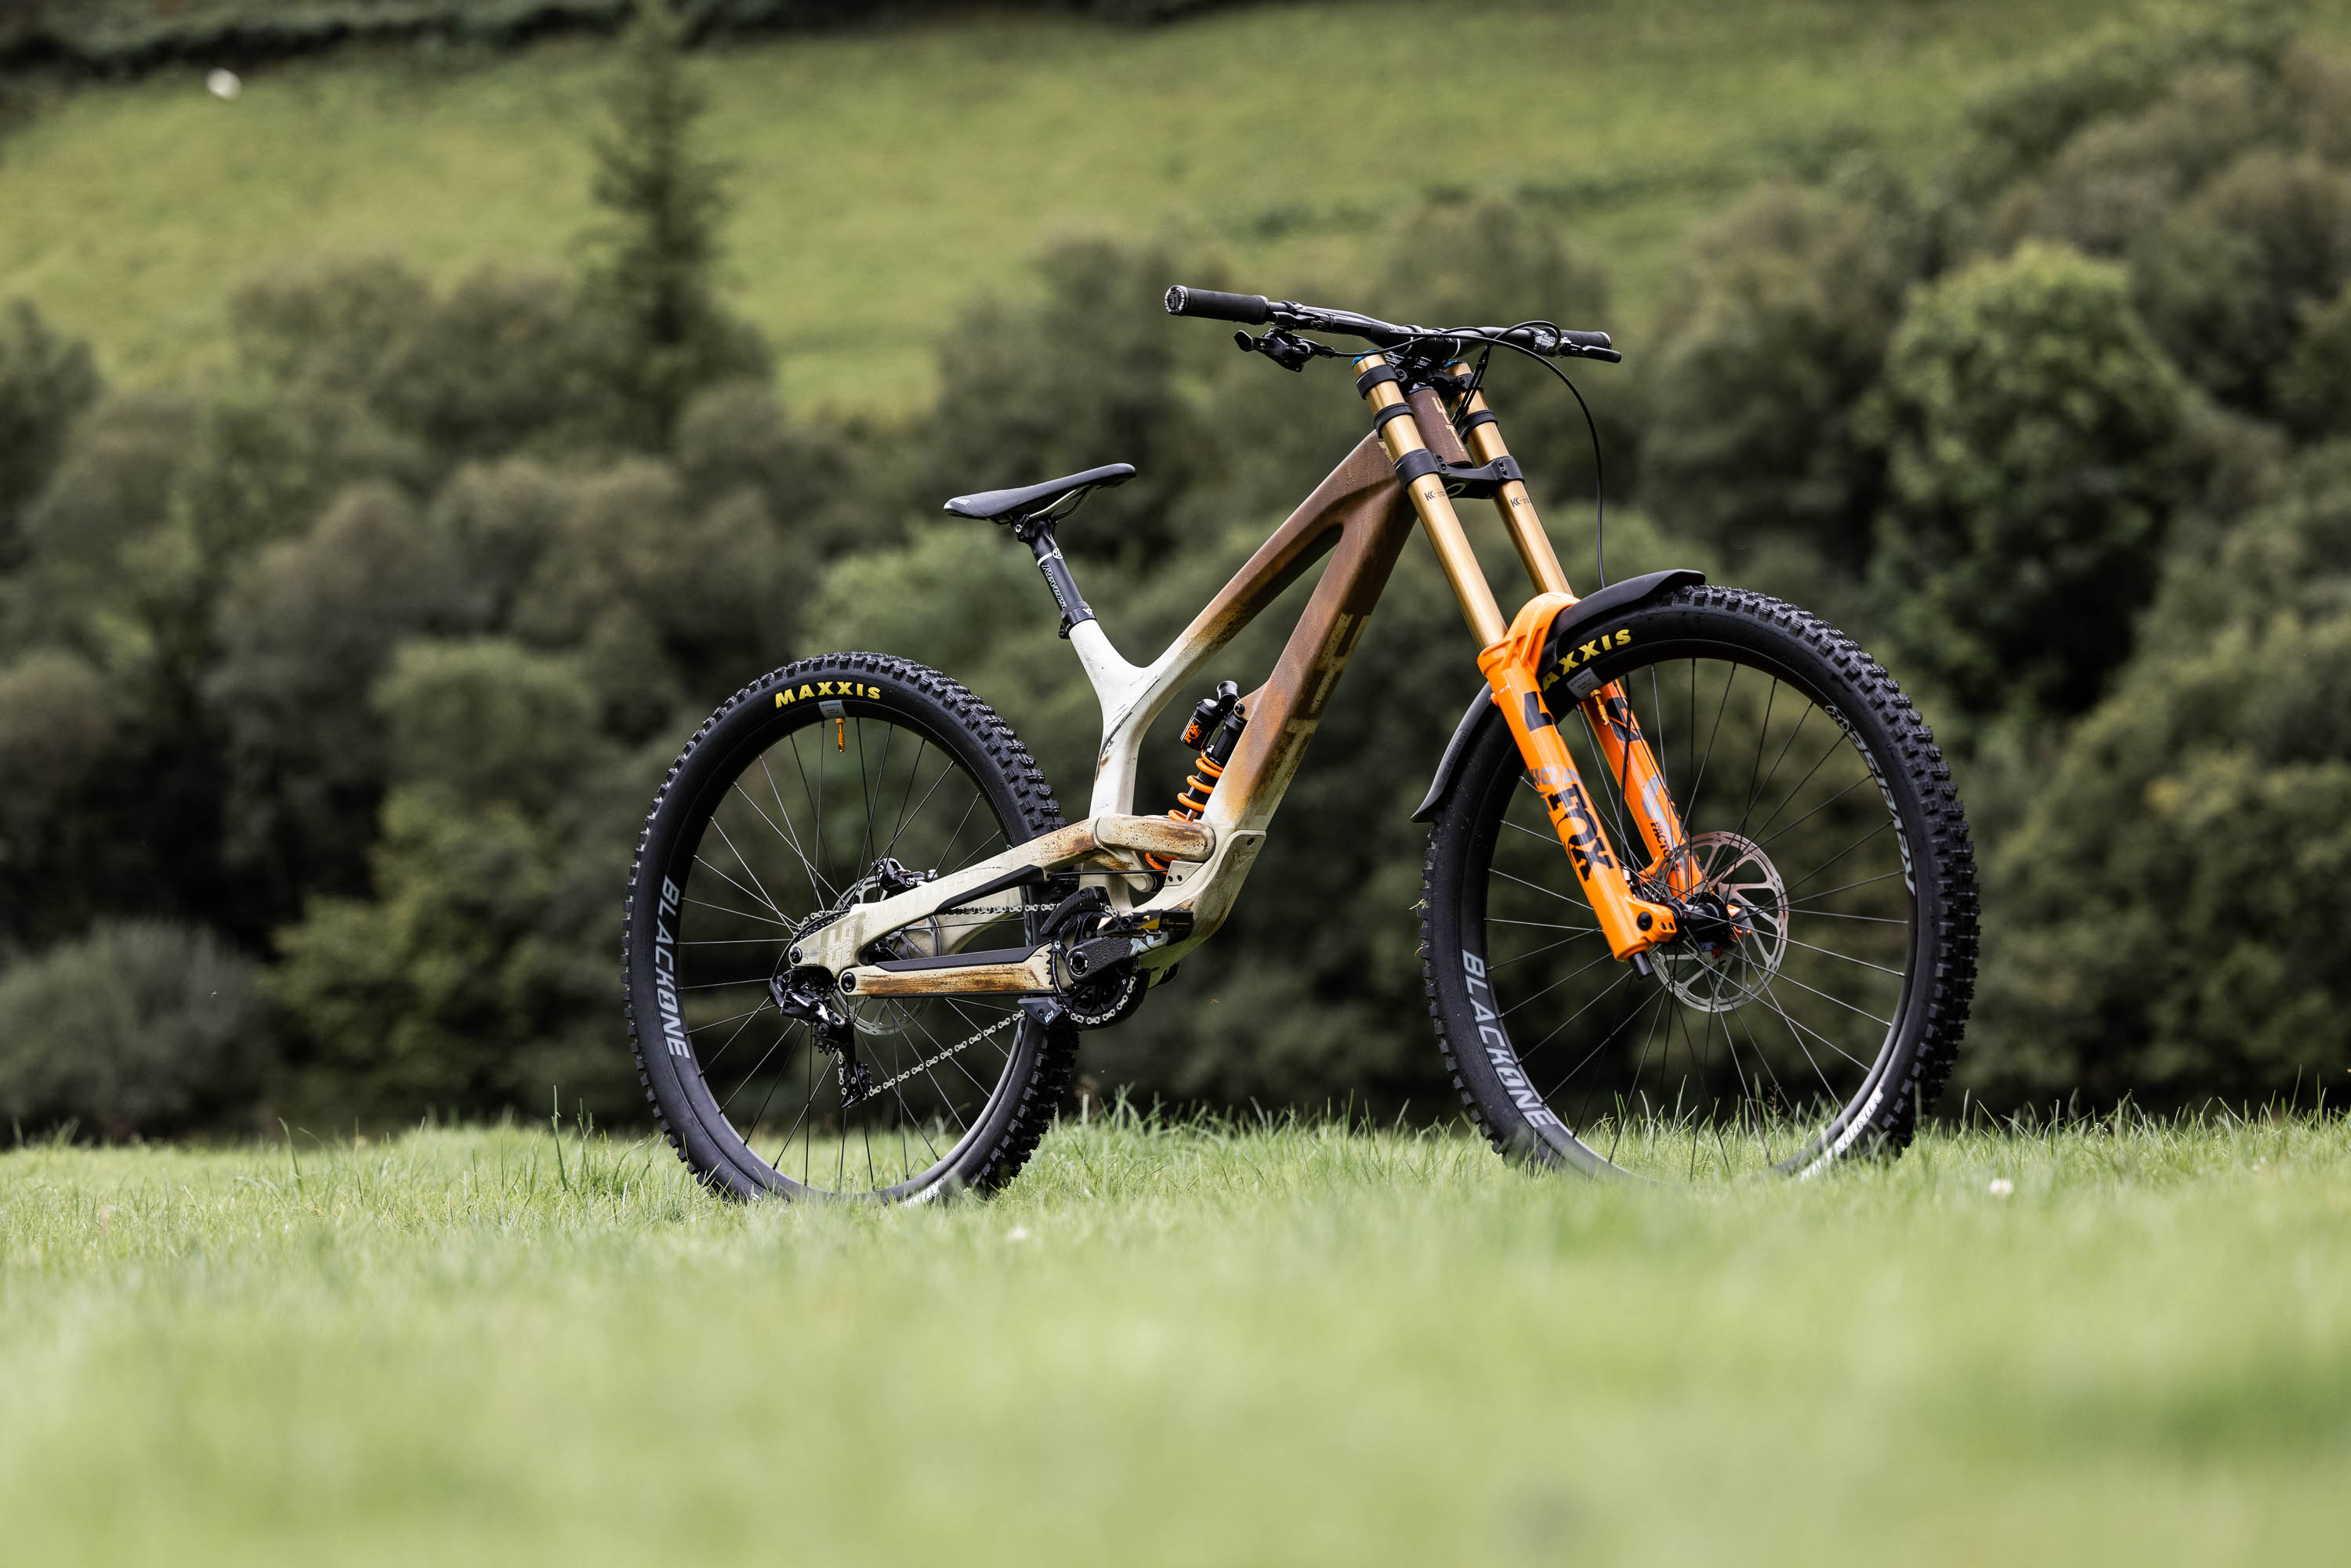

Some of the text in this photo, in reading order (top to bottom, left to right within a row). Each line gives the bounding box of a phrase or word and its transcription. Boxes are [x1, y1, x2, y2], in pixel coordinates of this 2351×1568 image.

[1541, 628, 1632, 692] AXXIS
[775, 681, 881, 709] MAXXIS
[1547, 783, 1615, 882] FOX
